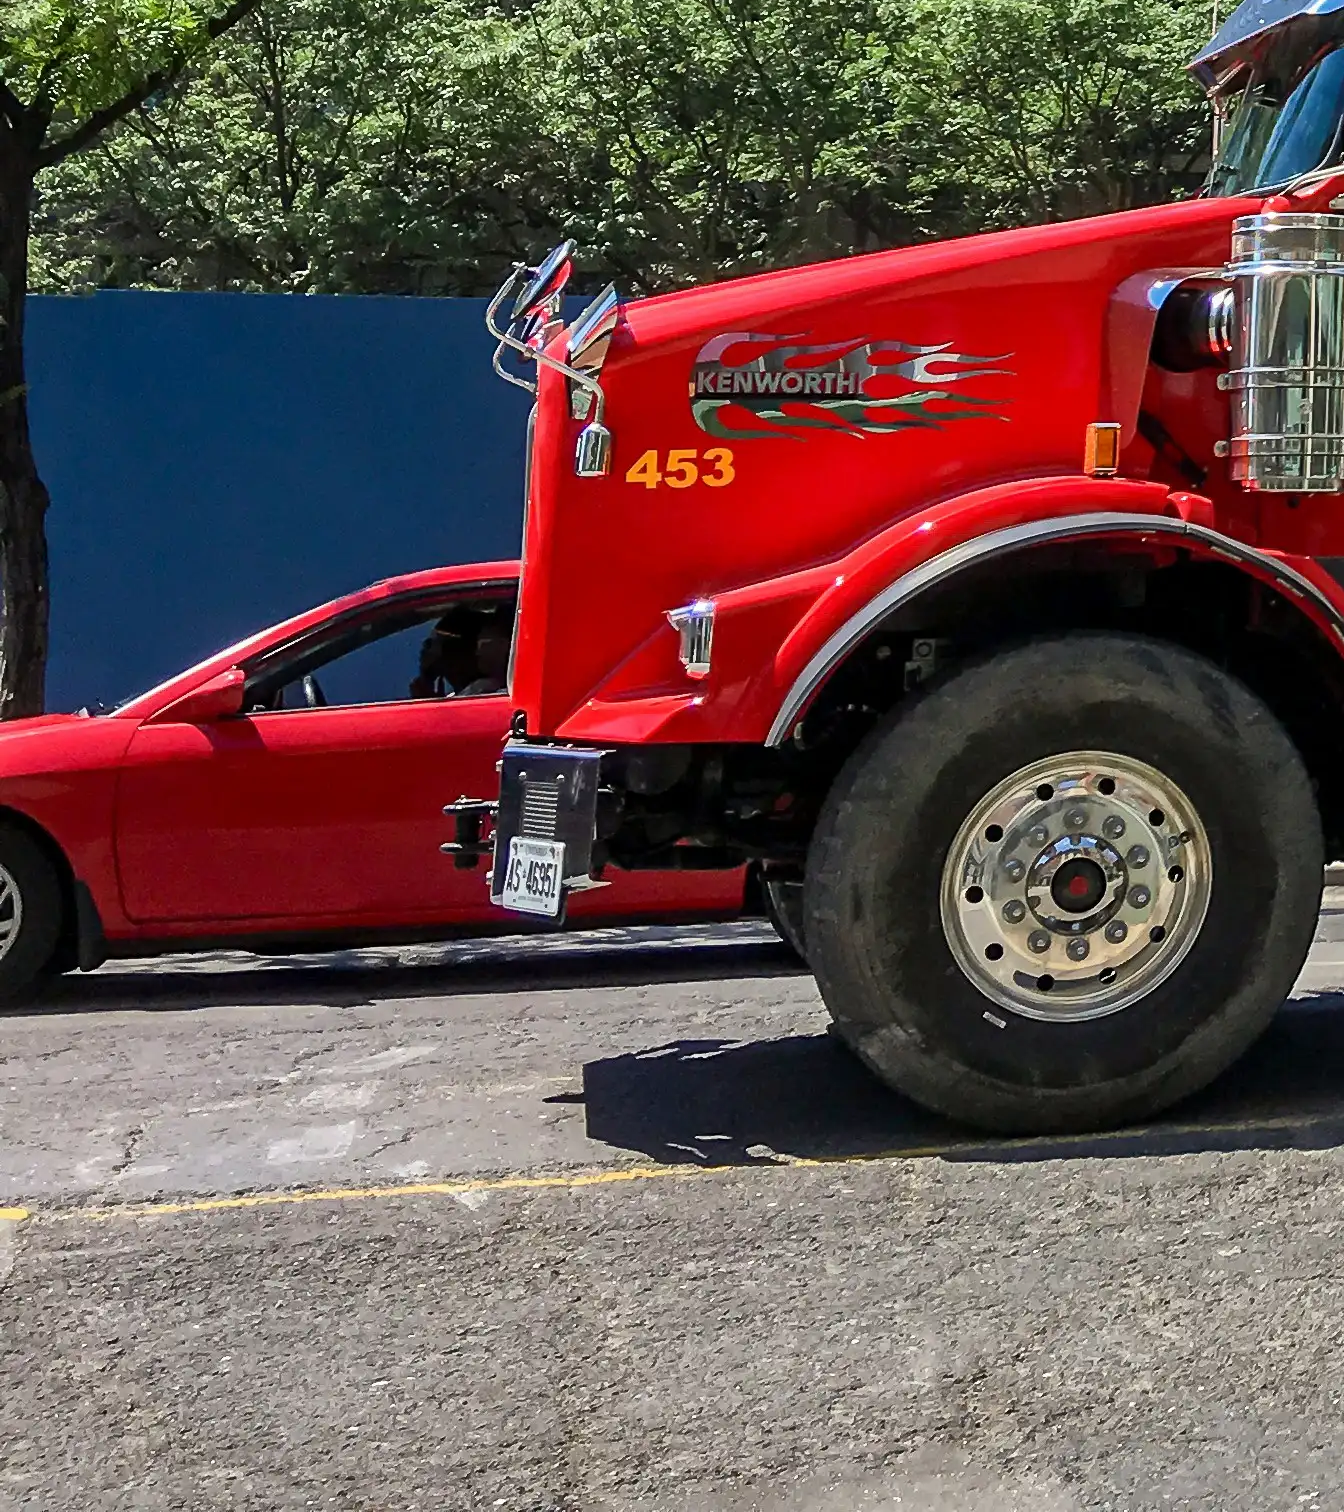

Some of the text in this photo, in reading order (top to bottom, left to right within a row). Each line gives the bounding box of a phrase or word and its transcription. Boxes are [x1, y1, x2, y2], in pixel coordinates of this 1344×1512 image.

[696, 370, 857, 395] KENWORTH
[625, 447, 736, 489] 453
[505, 857, 523, 893] AS
